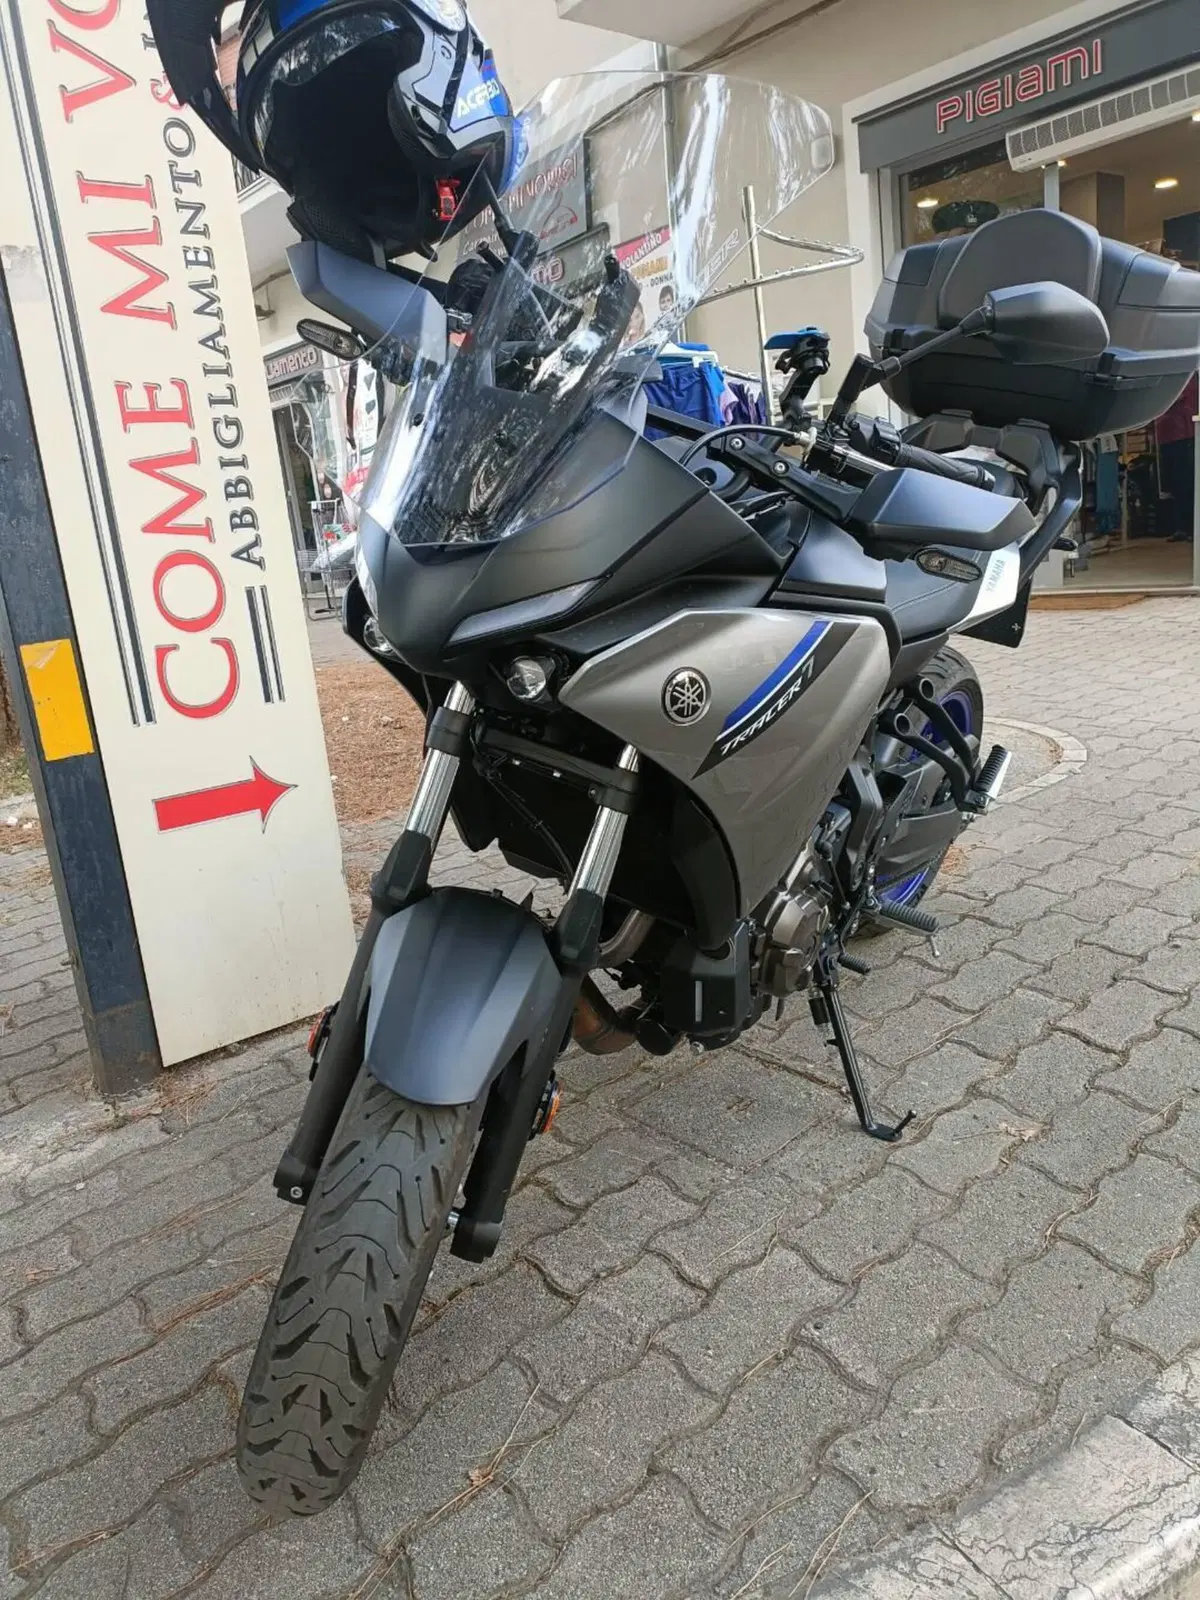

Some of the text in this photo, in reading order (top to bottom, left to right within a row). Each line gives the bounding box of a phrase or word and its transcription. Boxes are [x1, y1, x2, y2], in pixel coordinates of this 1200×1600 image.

[76, 170, 177, 330] MI
[162, 117, 266, 571] ABBIGLIAMENTO
[114, 377, 240, 719] COME
[984, 558, 1006, 593] YAMAHA
[720, 654, 816, 757] TRACER 7
